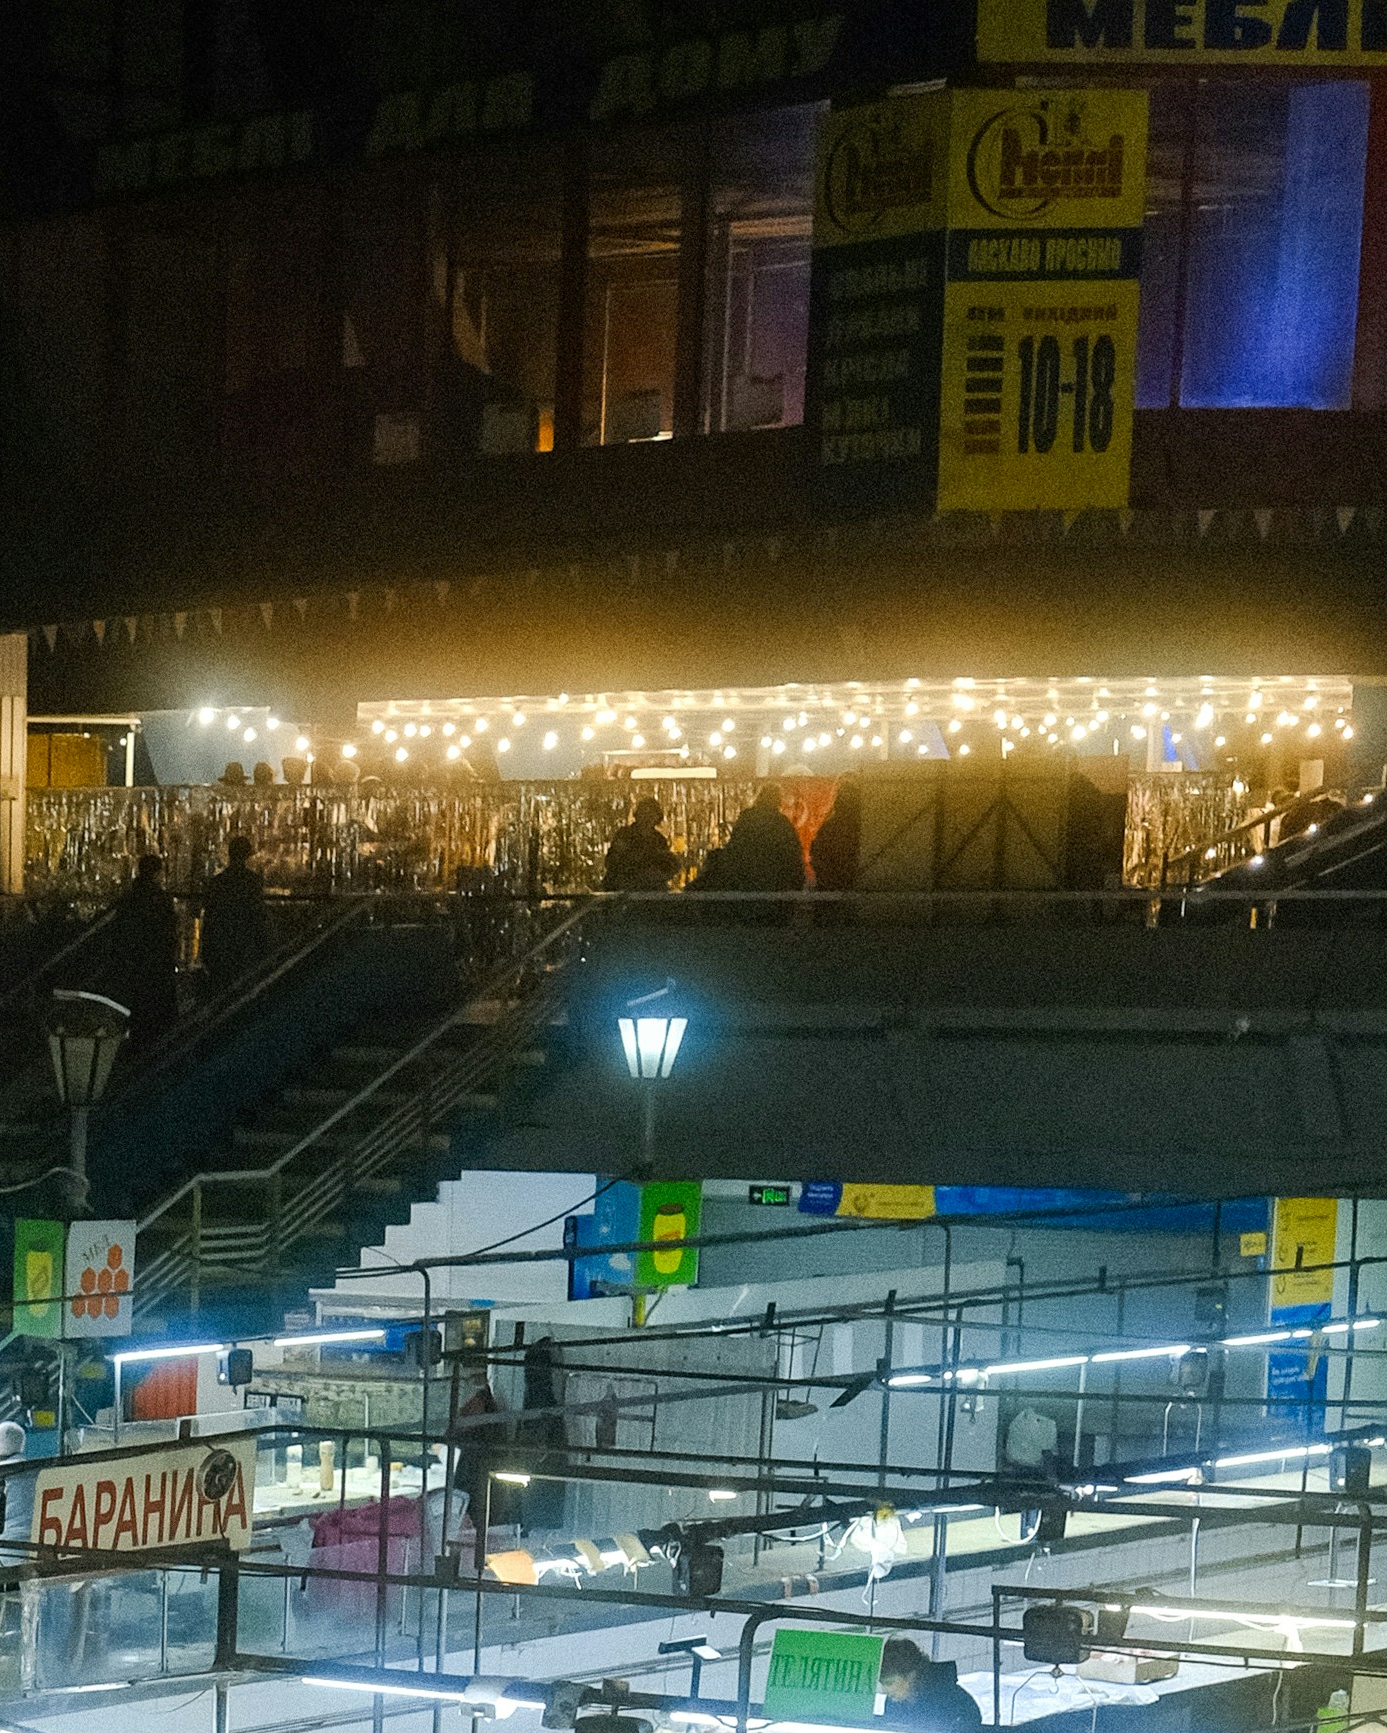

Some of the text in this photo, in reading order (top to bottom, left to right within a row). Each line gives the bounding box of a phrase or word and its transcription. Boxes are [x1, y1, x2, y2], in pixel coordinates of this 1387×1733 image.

[1018, 334, 1116, 454] 10-18
[38, 1460, 247, 1553] БАРАНИНА
[770, 1653, 875, 1695] ТЕЛЯТИНА
